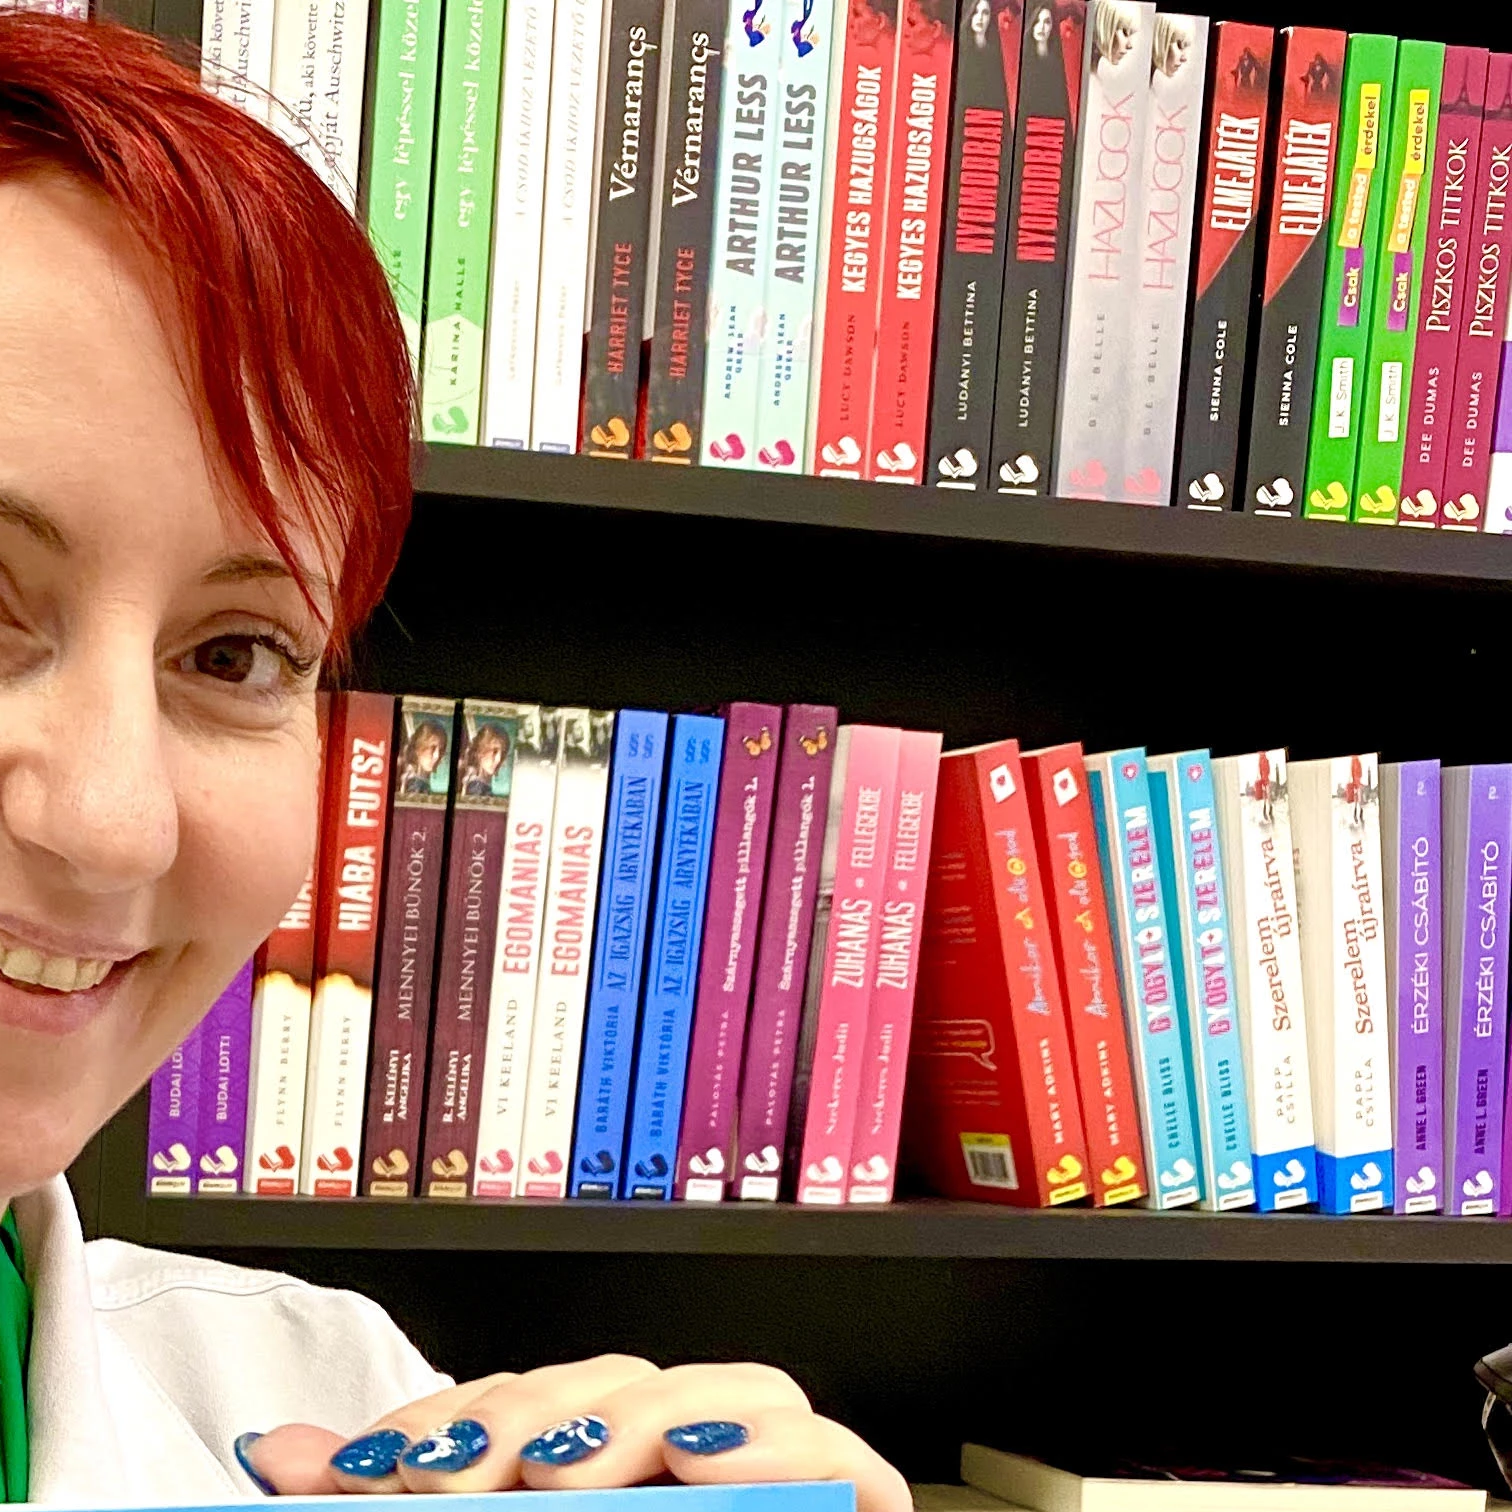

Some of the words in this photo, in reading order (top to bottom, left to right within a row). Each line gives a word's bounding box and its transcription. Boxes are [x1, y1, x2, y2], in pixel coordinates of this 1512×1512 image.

[609, 26, 658, 201] Vérnarançs
[672, 31, 721, 208] Vérnarançs
[734, 74, 768, 141] LESS
[783, 83, 817, 151] LESS
[848, 65, 882, 204] HAZUGSÁGOK
[903, 73, 937, 212] HAZUGSÁGOK
[1210, 113, 1260, 231] ELMEJÁTÉK
[1279, 119, 1332, 236] ELMEJÁTÉK
[1439, 137, 1469, 230] TITKOK
[1483, 143, 1512, 235] TITKOK
[726, 152, 762, 277] ARTHUR
[775, 161, 812, 284] ARTHUR
[842, 211, 871, 293] KEGYES
[612, 242, 632, 291] TYCE
[676, 248, 695, 296] TYCE
[897, 218, 926, 300] KEGYES
[1425, 238, 1457, 332] PISZKOS
[1469, 244, 1500, 337] PISZKOS
[608, 297, 630, 374] HARRIET
[670, 304, 692, 379] HARRIET
[1215, 320, 1228, 360] COLE
[1285, 325, 1298, 365] COLE
[1210, 365, 1224, 421] SIENNA
[1279, 371, 1293, 426] SIENNA
[1424, 367, 1440, 425] DUMAS
[1466, 371, 1483, 429] DUMAS
[1420, 431, 1430, 463] DEE
[1462, 436, 1474, 467] DEE
[347, 737, 386, 827] FUTSZ
[338, 845, 377, 932] HIÁBA
[502, 821, 544, 975] EGOMÁNIÁS
[551, 825, 594, 977] EGOMÁNIÁS
[1261, 838, 1294, 938] újraírva
[1351, 840, 1378, 943] újraírva
[1413, 837, 1429, 946] CSÁBÍTÓ
[1479, 841, 1499, 950] CSÁBÍTÓ
[831, 898, 873, 989] ZUHANÁS
[876, 900, 916, 990] ZUHANÁS
[1256, 916, 1292, 1032] Szerelem
[1343, 918, 1374, 1035] Szerelem
[1410, 952, 1429, 1034] ÉRZÉKI
[1474, 957, 1495, 1038] ÉRZÉKI
[217, 1035, 231, 1073] LOTTI
[1276, 1066, 1284, 1119] PAPP
[1286, 1055, 1295, 1125] CSILLA
[1365, 1057, 1374, 1127] CSILLA
[169, 1073, 182, 1118] BUDAI
[216, 1078, 229, 1122] BUDAI
[1355, 1070, 1364, 1121] PAPP
